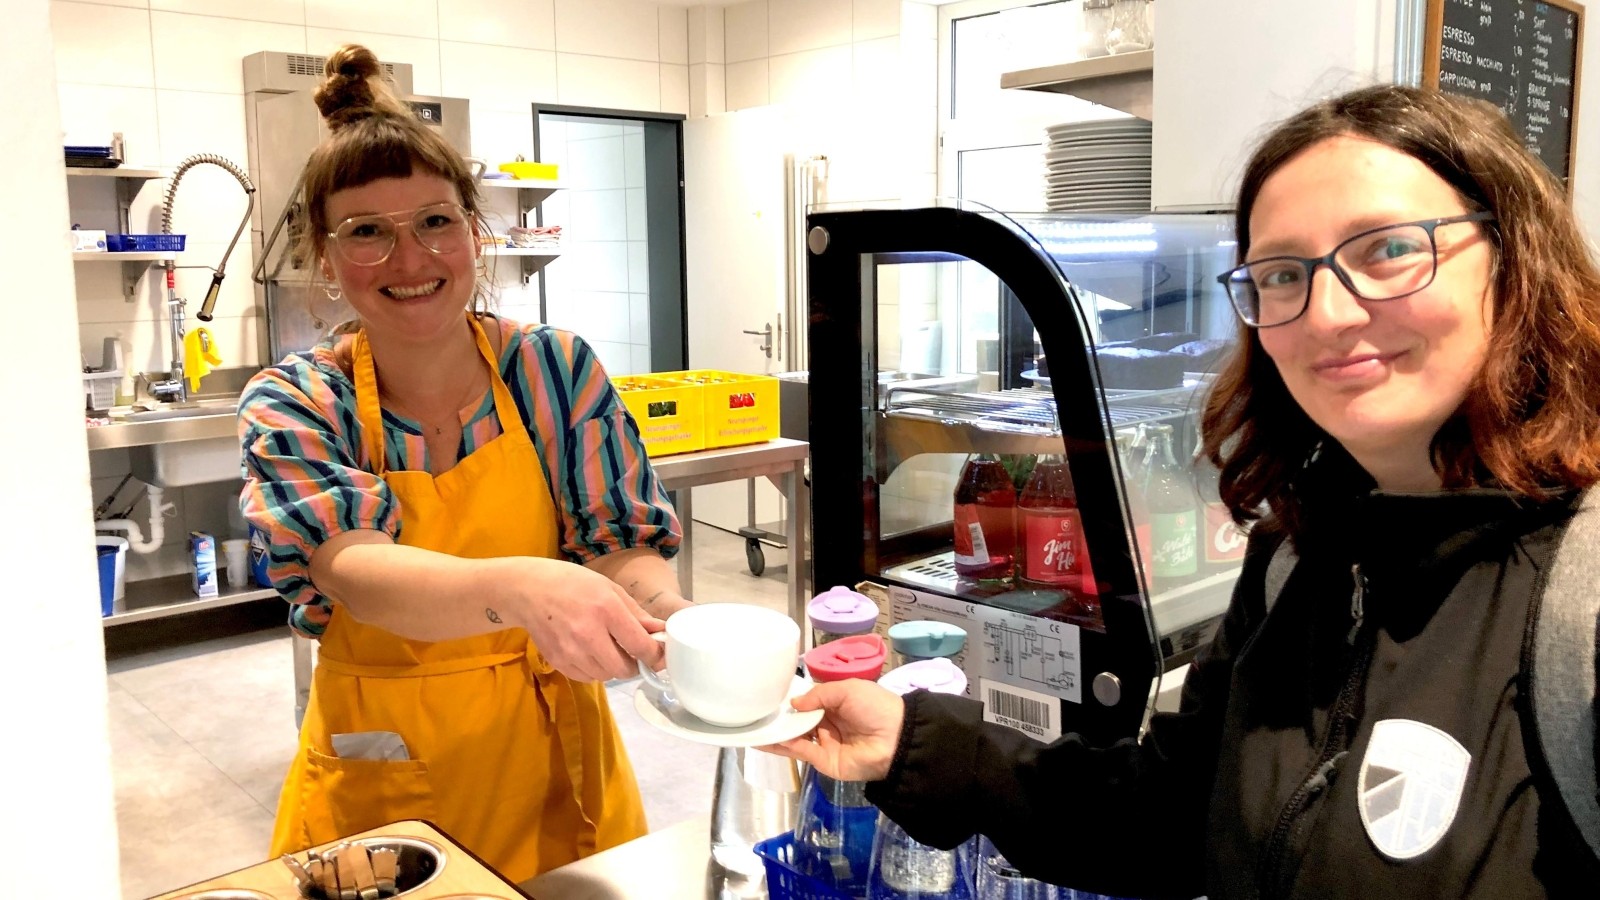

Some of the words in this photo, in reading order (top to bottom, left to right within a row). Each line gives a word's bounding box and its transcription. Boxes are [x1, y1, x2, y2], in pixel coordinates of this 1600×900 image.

[1443, 25, 1475, 46] ESPRESSO
[1441, 45, 1473, 65] ESPRESSO
[1476, 55, 1503, 73] MACCHIATO
[1439, 70, 1477, 90] CAPPUCCINO
[1043, 539, 1072, 566] Jim
